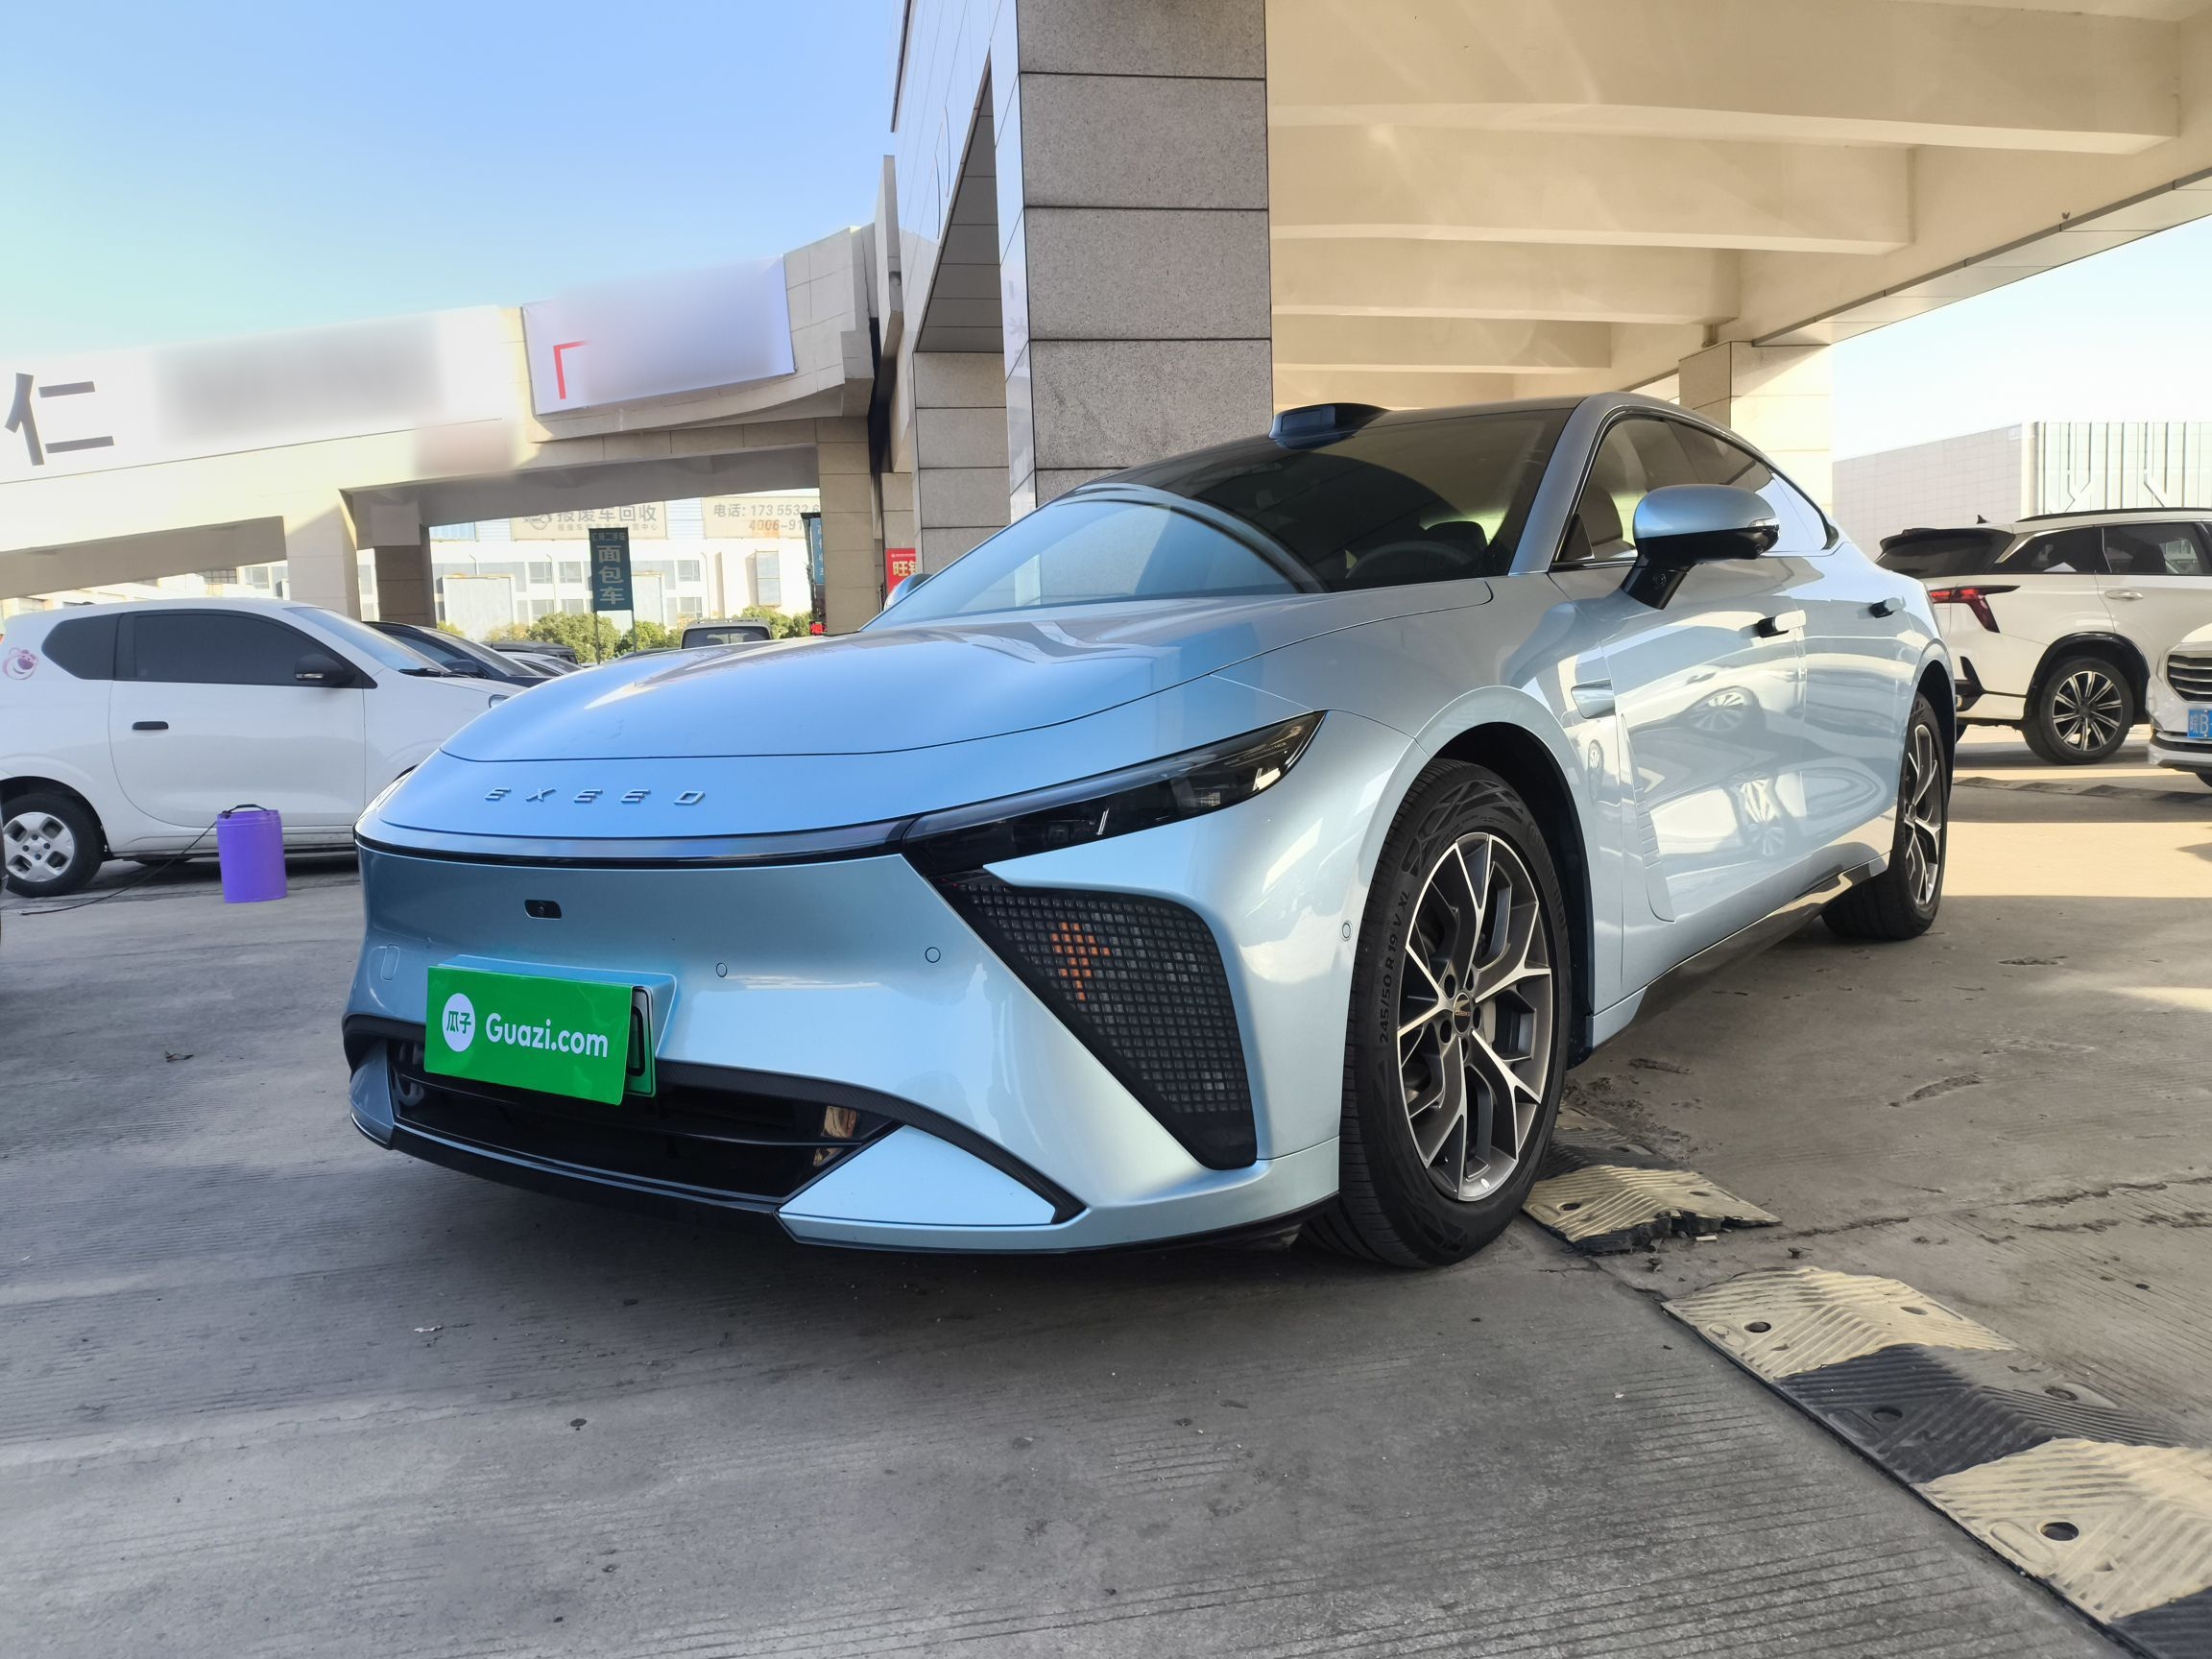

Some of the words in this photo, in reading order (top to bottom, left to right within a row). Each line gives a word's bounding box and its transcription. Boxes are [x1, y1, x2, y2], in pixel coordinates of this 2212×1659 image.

[4, 372, 115, 467] 仁
[751, 504, 774, 517] 173
[596, 544, 625, 605] 面包车
[484, 786, 706, 806] EXEED
[1398, 890, 1410, 912] XL
[1388, 933, 1399, 952] 19
[1385, 956, 1395, 970] R
[1379, 974, 1392, 1044] 245/50
[446, 1010, 472, 1034] 瓜子
[485, 1012, 609, 1058] Guazi.com
